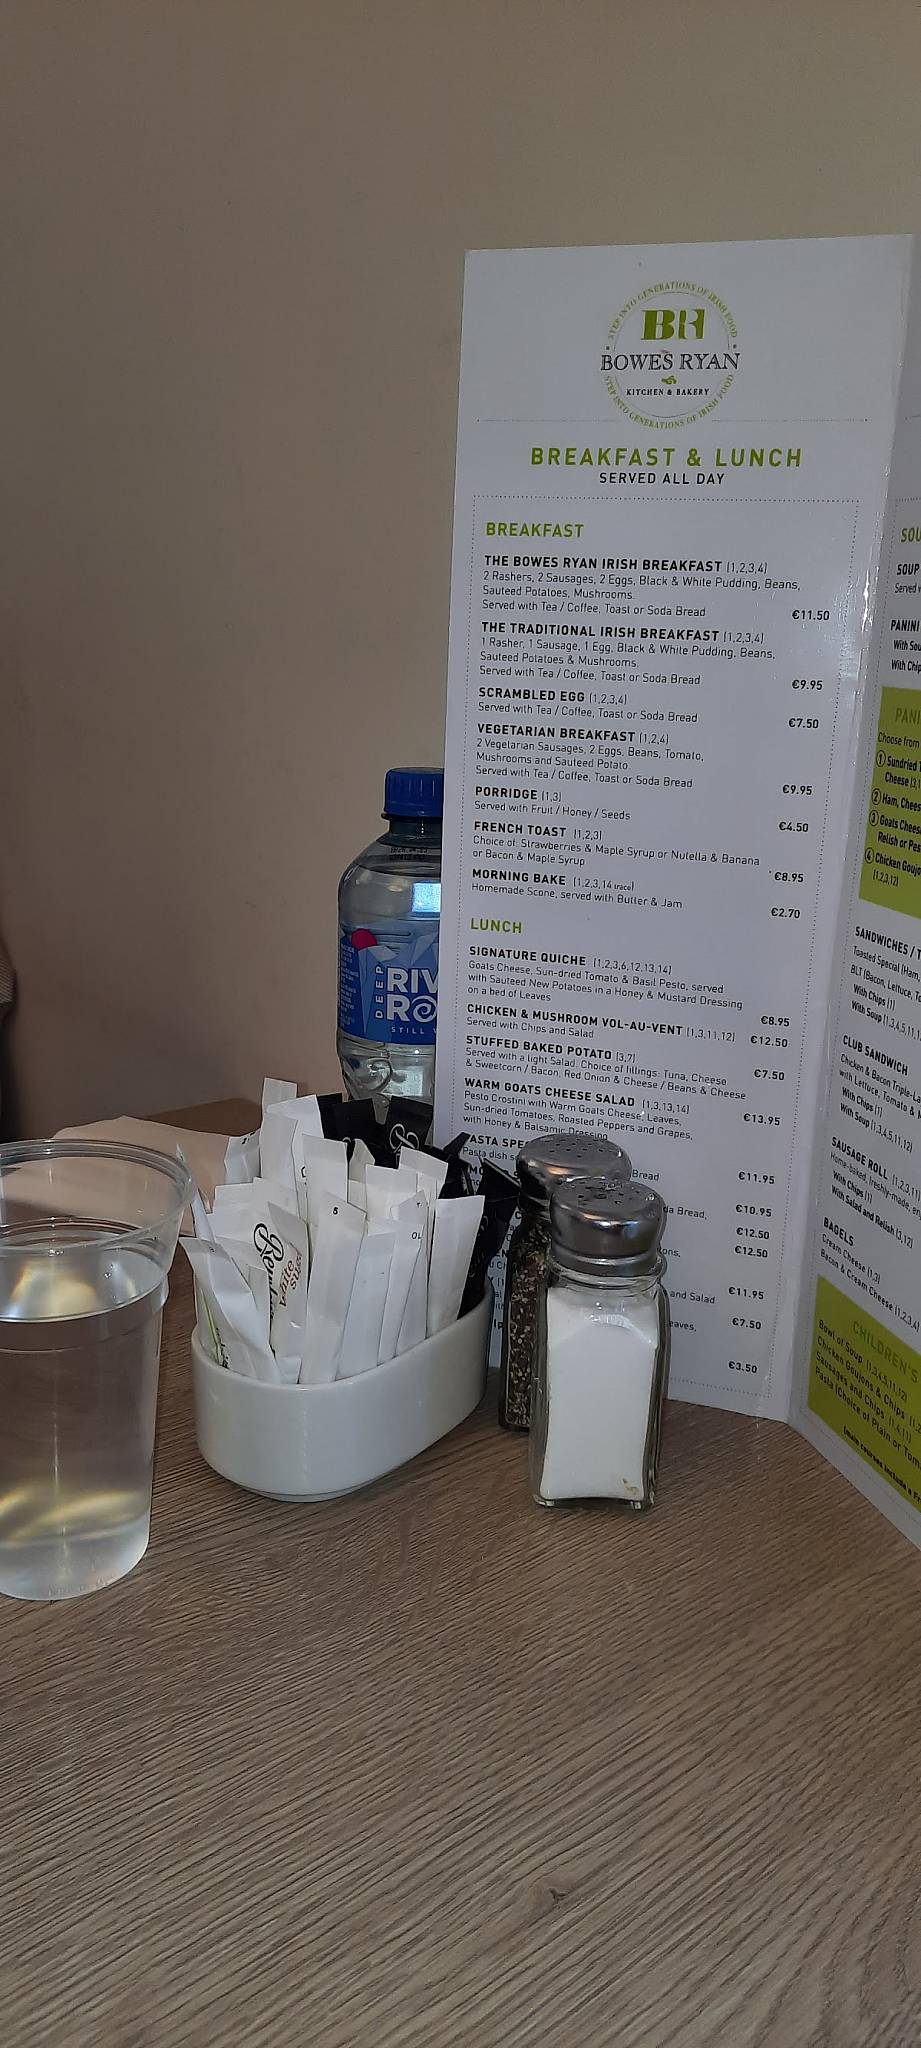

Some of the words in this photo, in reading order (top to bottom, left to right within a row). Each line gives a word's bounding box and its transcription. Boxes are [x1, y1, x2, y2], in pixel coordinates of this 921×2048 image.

[600, 354, 673, 371] BOWES
[679, 353, 740, 369] RYAN
[531, 447, 675, 465] BREAKFAST
[686, 448, 700, 466] &
[715, 448, 800, 466] LUNCH
[599, 472, 655, 483] SERVED
[662, 472, 689, 484] ALL
[696, 473, 724, 484] DAY
[486, 522, 584, 537] BREAKFAST
[484, 555, 508, 566] THE
[513, 556, 558, 567] BOWES
[563, 557, 597, 568] RYAN
[602, 558, 637, 569] IRISH
[642, 559, 722, 571] BREAKFAST
[726, 562, 767, 573] (1,2,3,4)
[897, 563, 920, 576] SOUP
[483, 570, 489, 580] 2
[492, 570, 534, 582] Rashers,
[537, 572, 543, 582] 2
[546, 572, 596, 585] Sausages,
[599, 573, 605, 583] 2
[608, 573, 635, 587] Eggs,
[639, 575, 667, 585] Black
[671, 575, 678, 585] &
[682, 576, 711, 586] White
[715, 577, 760, 590] Pudding,
[764, 578, 800, 590] Beans,
[791, 609, 829, 620] €11.50
[481, 621, 505, 632] THE
[509, 623, 595, 636] TRADITIONAL
[600, 626, 635, 637] IRISH
[640, 628, 719, 640] BREAKFAST
[723, 631, 763, 643] (1,2,3,4)
[891, 619, 920, 632] PANINI
[479, 665, 511, 675] Served
[514, 667, 534, 676] with
[537, 667, 553, 677] Tea
[556, 667, 561, 678] /
[563, 669, 596, 680] Coffee,
[600, 670, 625, 681] Toast
[642, 672, 666, 683] Soda
[670, 673, 700, 684] Bread
[791, 679, 822, 690] €9.95
[478, 687, 555, 700] SCRAMBLED
[560, 691, 584, 701] EGG
[589, 692, 626, 704] (1,2,3,4)
[788, 718, 818, 728] €7.50
[477, 723, 555, 737] VEGETARIAN
[559, 728, 635, 741] BREAKFAST
[639, 732, 668, 744] (1,2,4)
[878, 731, 902, 746] Choose
[903, 736, 920, 749] from
[476, 751, 531, 763] Mushrooms
[534, 756, 552, 764] and
[555, 756, 593, 767] Sauteed
[475, 786, 537, 799] PORRIDGE
[541, 790, 561, 801] (1,3)
[782, 784, 812, 795] €9.95
[474, 821, 522, 833] FRENCH
[527, 825, 566, 836] TOAST
[573, 829, 601, 840] (1,2,3)
[778, 821, 808, 832] €4.50
[472, 869, 528, 881] MORNING
[533, 873, 565, 885] BAKE
[774, 871, 803, 882] €8.95
[771, 907, 800, 918] €2.70
[470, 918, 521, 933] LUNCH
[855, 926, 909, 955] SANDWICHES
[469, 946, 536, 960] SIGNATURE
[541, 953, 586, 965] QUICHE
[593, 958, 671, 974] (1,2,3,6,12,13,14)
[387, 967, 438, 994] RIV
[375, 966, 384, 1019] DEEP
[489, 986, 505, 996] bed
[508, 989, 516, 997] of
[519, 990, 551, 1001] Leaves
[853, 983, 868, 998] With
[868, 990, 886, 1007] Chips
[387, 994, 437, 1023] RO
[467, 1003, 516, 1016] CHICKEN
[521, 1009, 528, 1018] &
[532, 1010, 597, 1025] MUSHROOM
[602, 1018, 683, 1034] VOL-AU-VENT
[686, 1027, 735, 1041] (1,3,11,12)
[760, 1015, 789, 1026] €8.95
[391, 1026, 425, 1035] STILL
[750, 1035, 787, 1047] €12.50
[466, 1035, 518, 1048] STUFFED
[523, 1041, 562, 1053] BAKED
[567, 1046, 611, 1059] POTATO
[616, 1051, 635, 1063] (3,7)
[842, 1035, 862, 1052] CLUB
[864, 1046, 907, 1075] SANDWICH
[754, 1069, 784, 1080] €7.50
[464, 1077, 499, 1089] WARM
[504, 1082, 540, 1094] GOATS
[545, 1087, 591, 1101] CHEESE
[595, 1093, 634, 1106] SALAD
[642, 1099, 689, 1114] (1,3,13,14)
[743, 1113, 780, 1125] €13.95
[831, 1136, 866, 1165] SAUSAGE
[867, 1159, 887, 1179] ROLL
[632, 1167, 659, 1180] Bread
[738, 1171, 774, 1184] €11.95
[677, 1206, 706, 1219] Bread,
[735, 1204, 771, 1216] €10.95
[736, 1227, 769, 1239] €12.50
[823, 1216, 854, 1247] BAGELS
[734, 1245, 767, 1257] €12.50
[822, 1233, 842, 1255] Cream
[842, 1249, 866, 1273] Cheese
[728, 1286, 763, 1299] €11.95
[732, 1317, 761, 1329] €7.50
[853, 1320, 918, 1384] CHILDREN'S
[728, 1361, 757, 1373] €3.50
